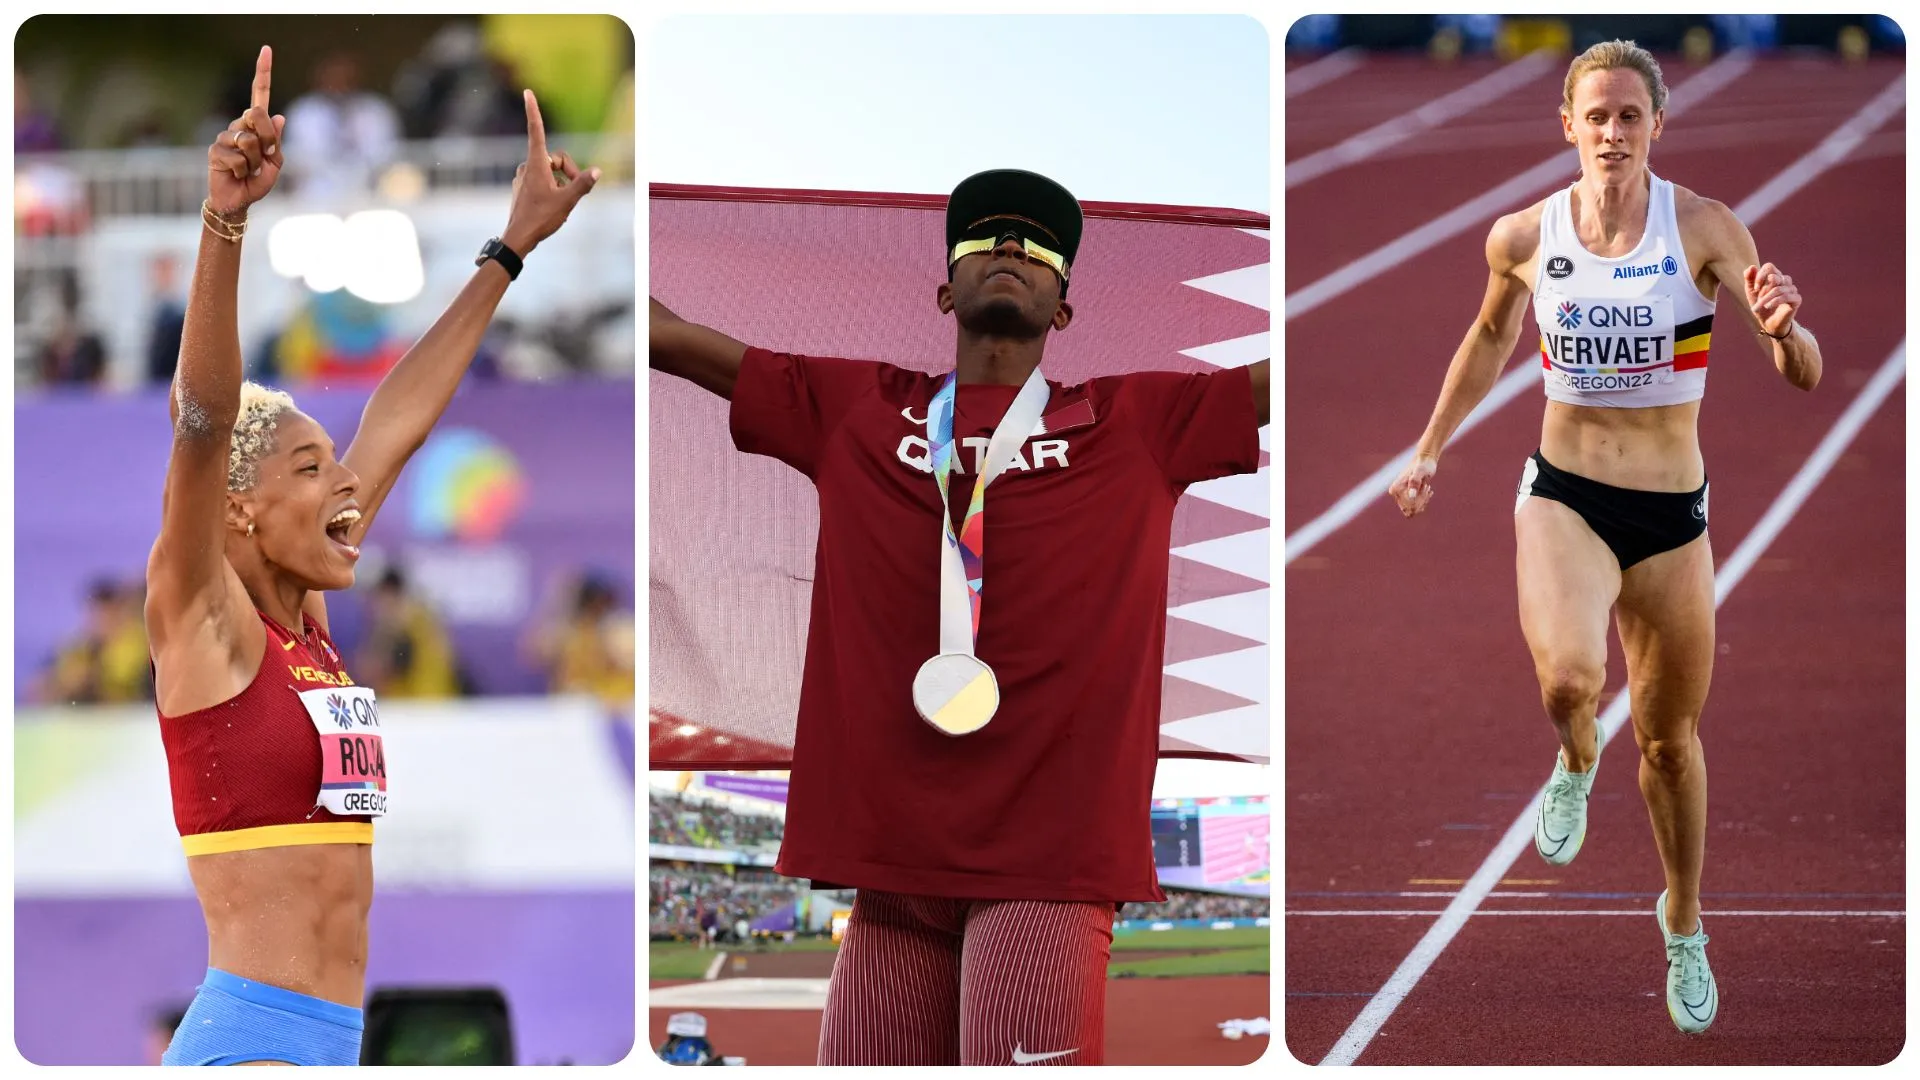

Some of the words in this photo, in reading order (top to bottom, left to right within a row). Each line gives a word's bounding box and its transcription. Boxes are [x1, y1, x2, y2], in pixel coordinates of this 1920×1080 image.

[1613, 263, 1660, 279] Allianz
[1588, 305, 1654, 328] QNB
[1546, 333, 1667, 365] VERVAET
[1564, 373, 1653, 390] OREGON22
[353, 696, 380, 728] QN
